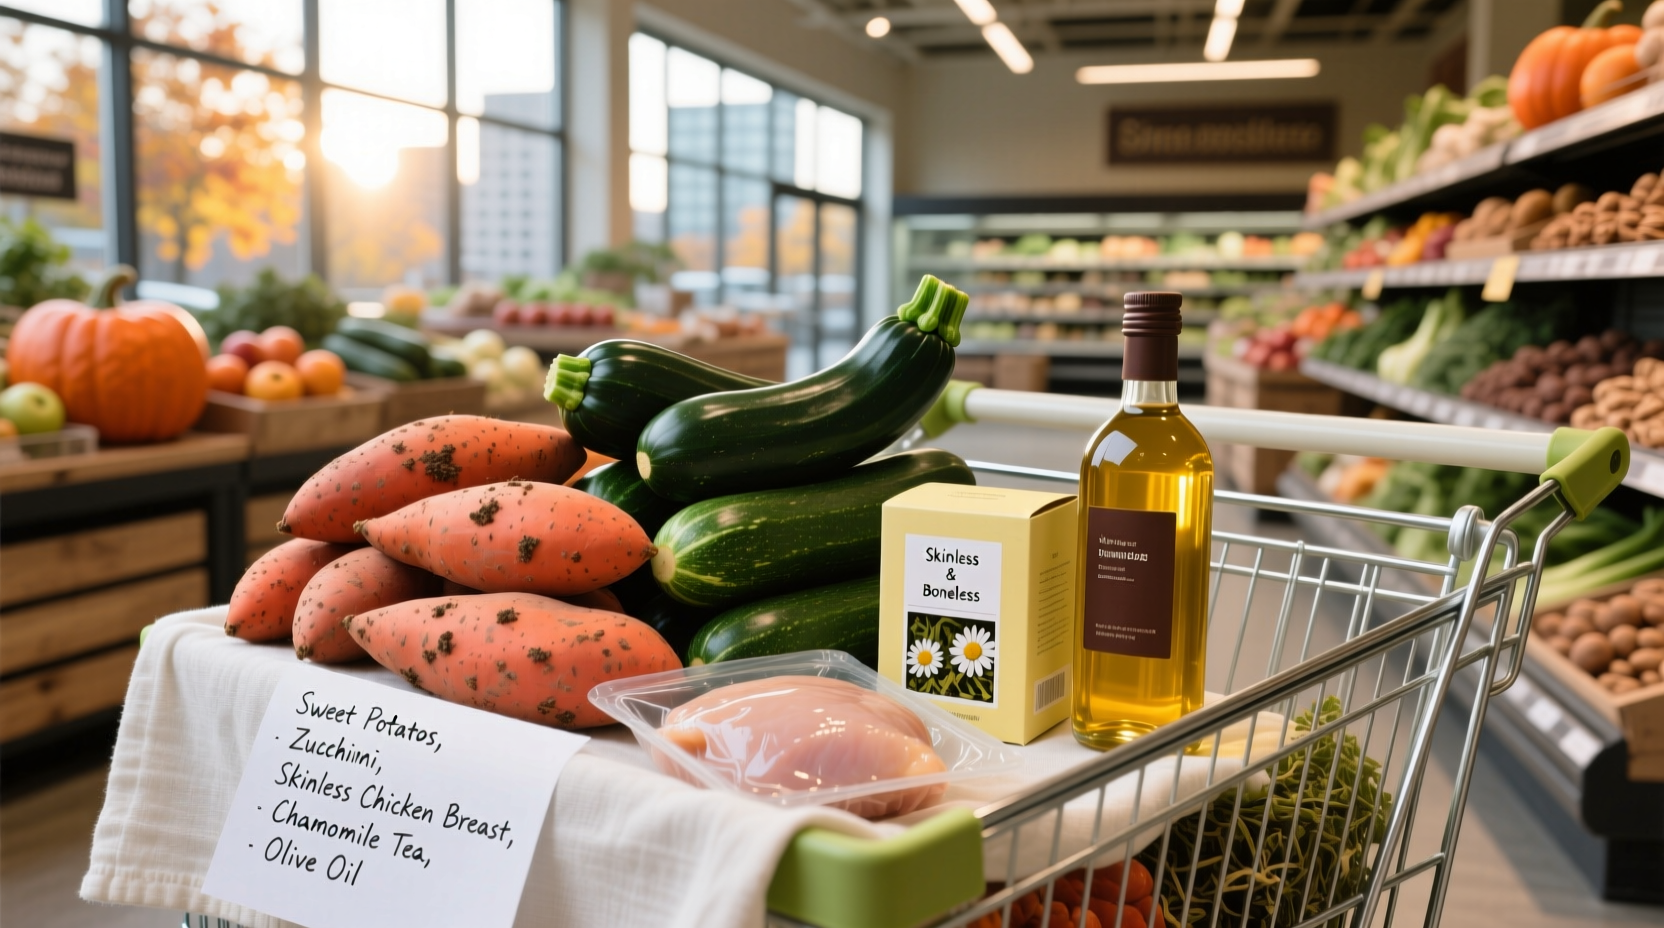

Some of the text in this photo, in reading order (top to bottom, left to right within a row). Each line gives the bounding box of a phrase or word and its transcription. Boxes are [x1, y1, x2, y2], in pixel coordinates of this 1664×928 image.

[925, 546, 980, 566] Skinless
[945, 567, 957, 581] &
[922, 583, 980, 602] Boneless
[295, 691, 357, 725] Sweet
[274, 761, 513, 849] Skinless Chicken Breast,
[272, 799, 431, 869] Chamomile Tea,
[264, 836, 364, 886] Olive Oil
